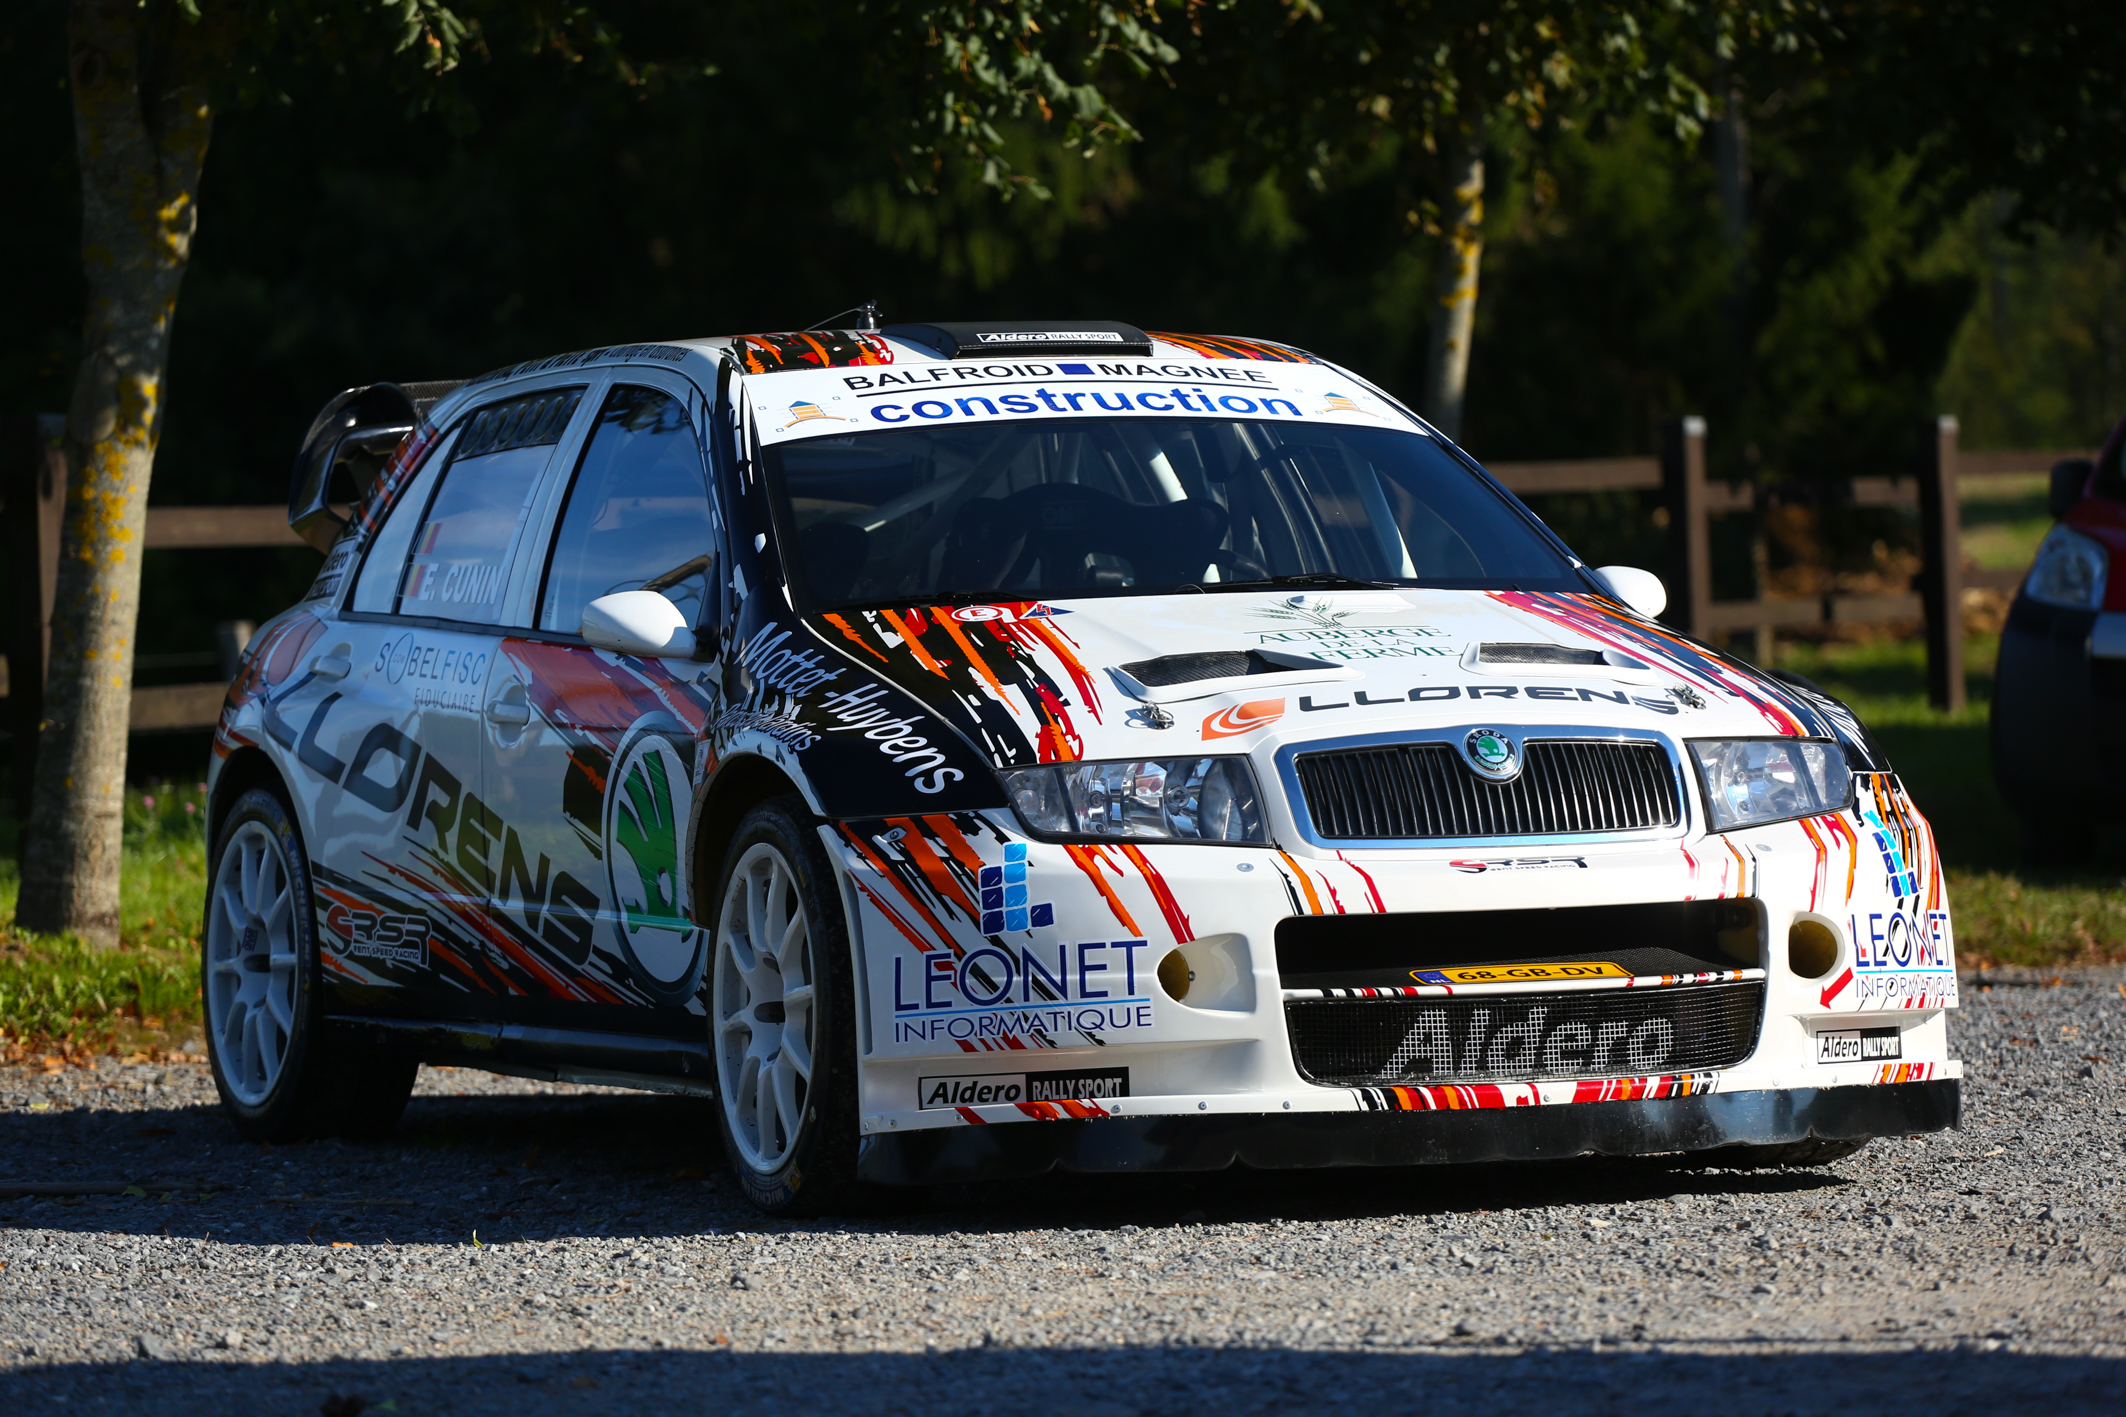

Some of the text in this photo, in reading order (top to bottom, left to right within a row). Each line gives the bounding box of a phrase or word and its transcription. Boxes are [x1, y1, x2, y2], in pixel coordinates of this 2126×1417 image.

[843, 363, 1273, 390] BALFROID MAGNEE
[871, 388, 1303, 423] construction
[419, 563, 505, 605] E. CUNIN
[1259, 628, 1451, 644] AUBERGE
[1317, 640, 1365, 649] DE
[374, 632, 486, 685] SOBELFISC
[734, 622, 847, 698] Mottet
[1308, 646, 1463, 660] FERME
[414, 687, 476, 713] FIDUCIAIRE
[1298, 685, 1680, 715] LLORENS
[263, 672, 601, 966] LLORENS
[353, 945, 420, 960] RENT SPEED RACING
[1851, 912, 1949, 967] LEONET
[894, 940, 1148, 1011] LEONET
[1457, 966, 1604, 981] 68-GB-DV
[1856, 976, 1955, 998] INFORMATIQUE
[895, 1005, 1152, 1043] INFORMATIQUE
[1375, 1006, 1675, 1079] Aldero
[1821, 1036, 1899, 1058] Aldero RALLY SPORT
[927, 1077, 1122, 1105] Aldero RALLY SPORT
[741, 1175, 785, 1206] MICHELIN
